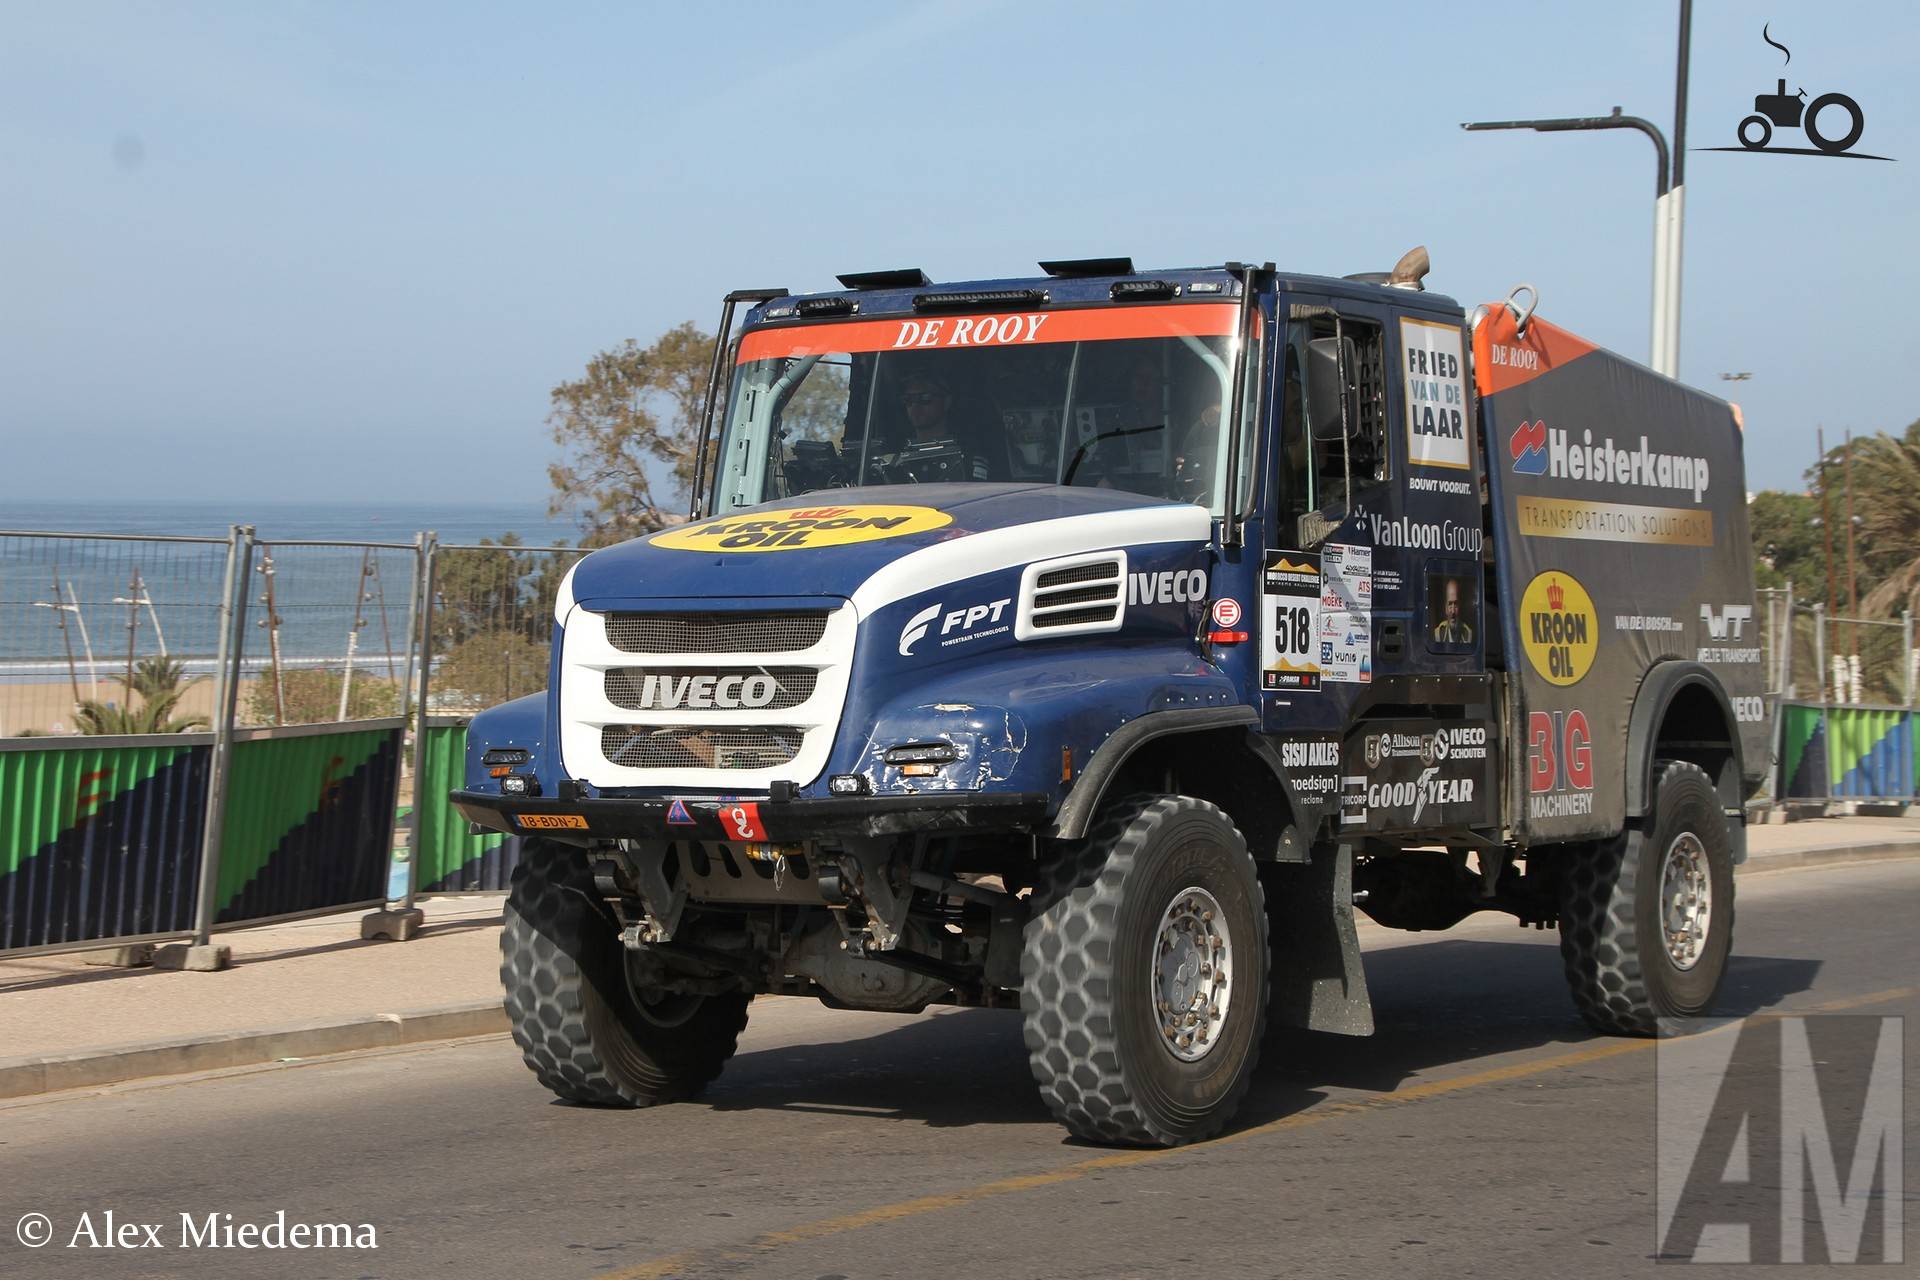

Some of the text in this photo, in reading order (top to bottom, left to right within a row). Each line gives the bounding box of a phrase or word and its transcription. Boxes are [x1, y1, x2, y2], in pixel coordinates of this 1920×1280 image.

[892, 315, 1049, 348] DE ROOY
[1408, 348, 1459, 379] FRIED
[1491, 343, 1538, 370] DE ROOY
[1410, 379, 1461, 405] VAN DE
[1411, 404, 1464, 440] LAAR
[1548, 427, 1710, 503] Heisterkamp
[1409, 477, 1472, 495] BOUWT VOORUIT.
[687, 516, 913, 538] KROON
[1525, 506, 1707, 539] TRANSPORTATION SOLUTIONS
[718, 530, 814, 548] OIL
[1443, 519, 1483, 560] Group
[1128, 569, 1207, 606] IVECO
[1358, 581, 1371, 593] ATS
[1219, 605, 1234, 617] E
[1322, 596, 1343, 608] MOEKE
[940, 598, 1011, 635] FPT
[1530, 612, 1588, 644] KROON
[1615, 615, 1629, 630] VAN
[1629, 615, 1645, 630] DEN
[1700, 603, 1752, 641] WT
[941, 625, 1009, 647] POWERTRAIN TECHNOLOGIES
[1275, 606, 1311, 654] 518
[1548, 646, 1574, 679] OIL
[1722, 648, 1761, 663] TRANSPORT
[640, 675, 777, 708] IVECO
[1731, 696, 1765, 722] ECO
[1391, 733, 1421, 748] Allison
[1450, 727, 1486, 745] IVECO
[1281, 742, 1339, 767] SISU AXLES
[1450, 748, 1486, 759] SCHOUTEN
[1528, 709, 1594, 794] BIG
[1341, 794, 1367, 806] TRICORP
[1530, 793, 1594, 819] MACHINERY
[520, 815, 582, 828] 18-BDN-2
